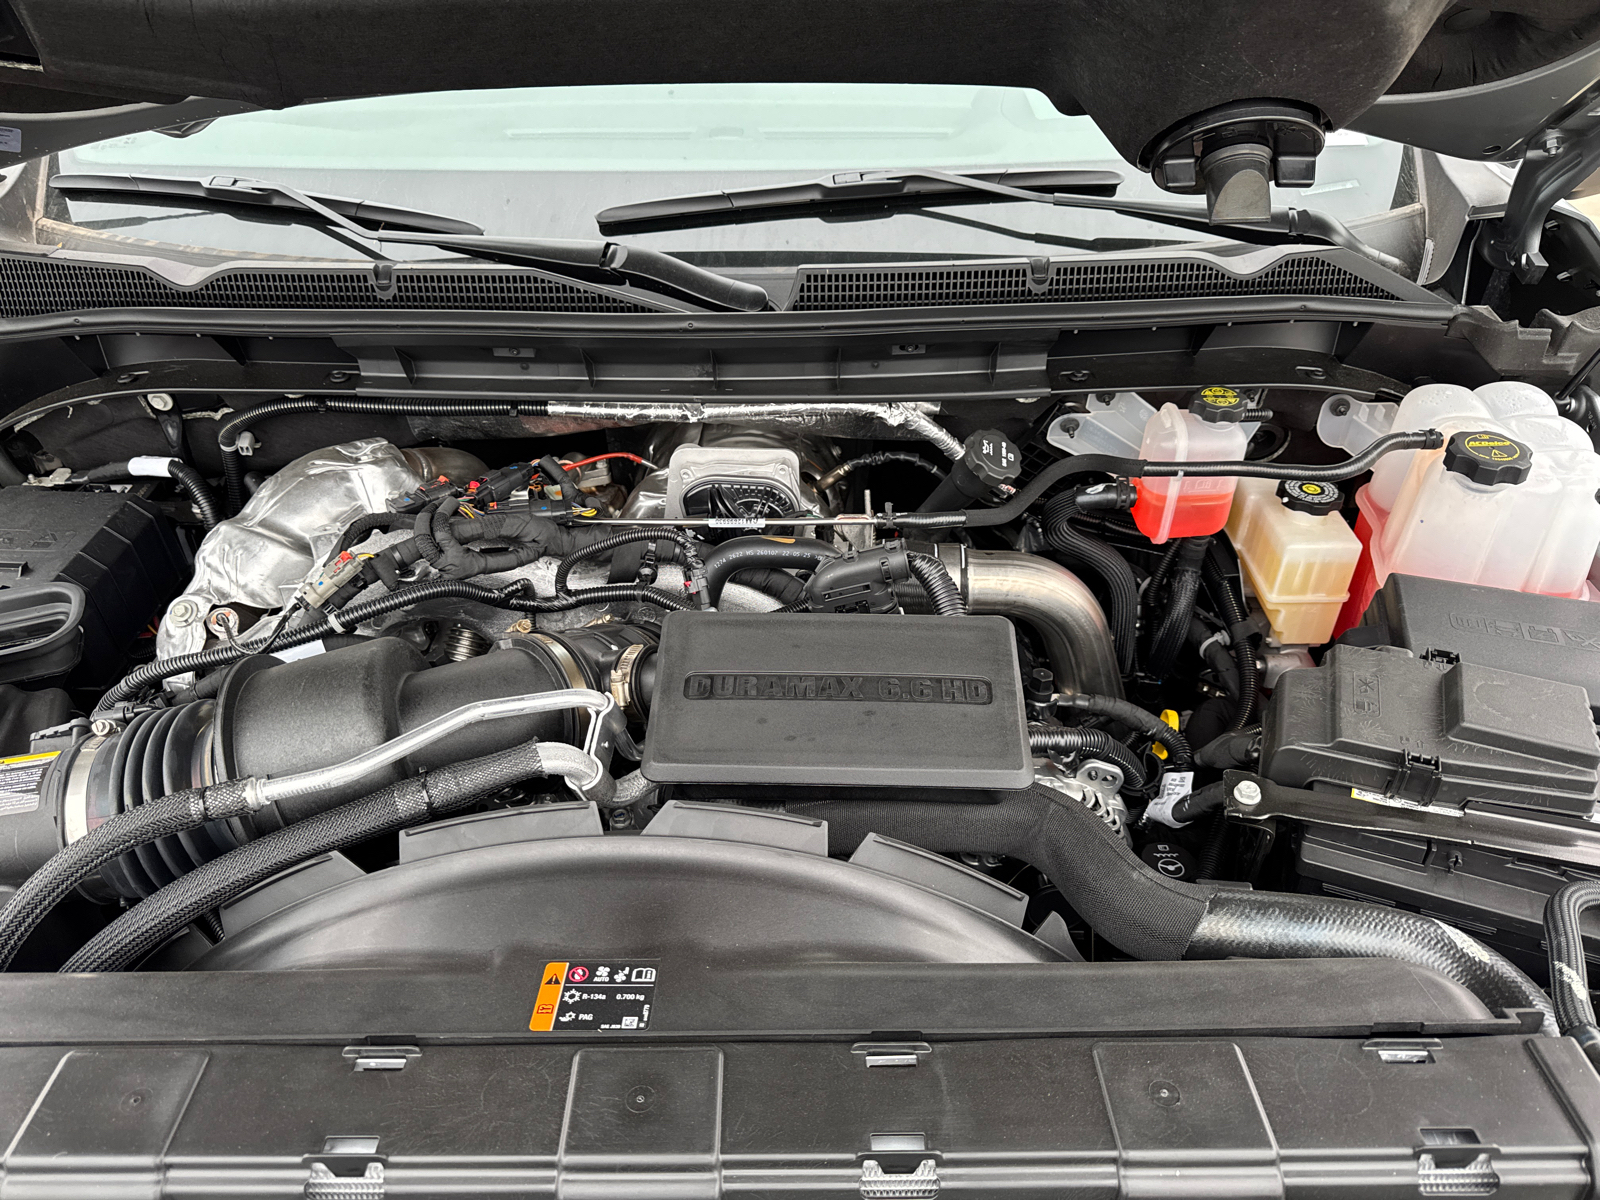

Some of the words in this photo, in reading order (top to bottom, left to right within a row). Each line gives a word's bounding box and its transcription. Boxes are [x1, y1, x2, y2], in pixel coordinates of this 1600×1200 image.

[1468, 440, 1511, 448] ACDelco
[688, 675, 864, 698] DURAMAX
[878, 677, 934, 701] 6.6
[941, 679, 989, 703] HD
[635, 993, 646, 1001] kg
[578, 1013, 594, 1021] PAG
